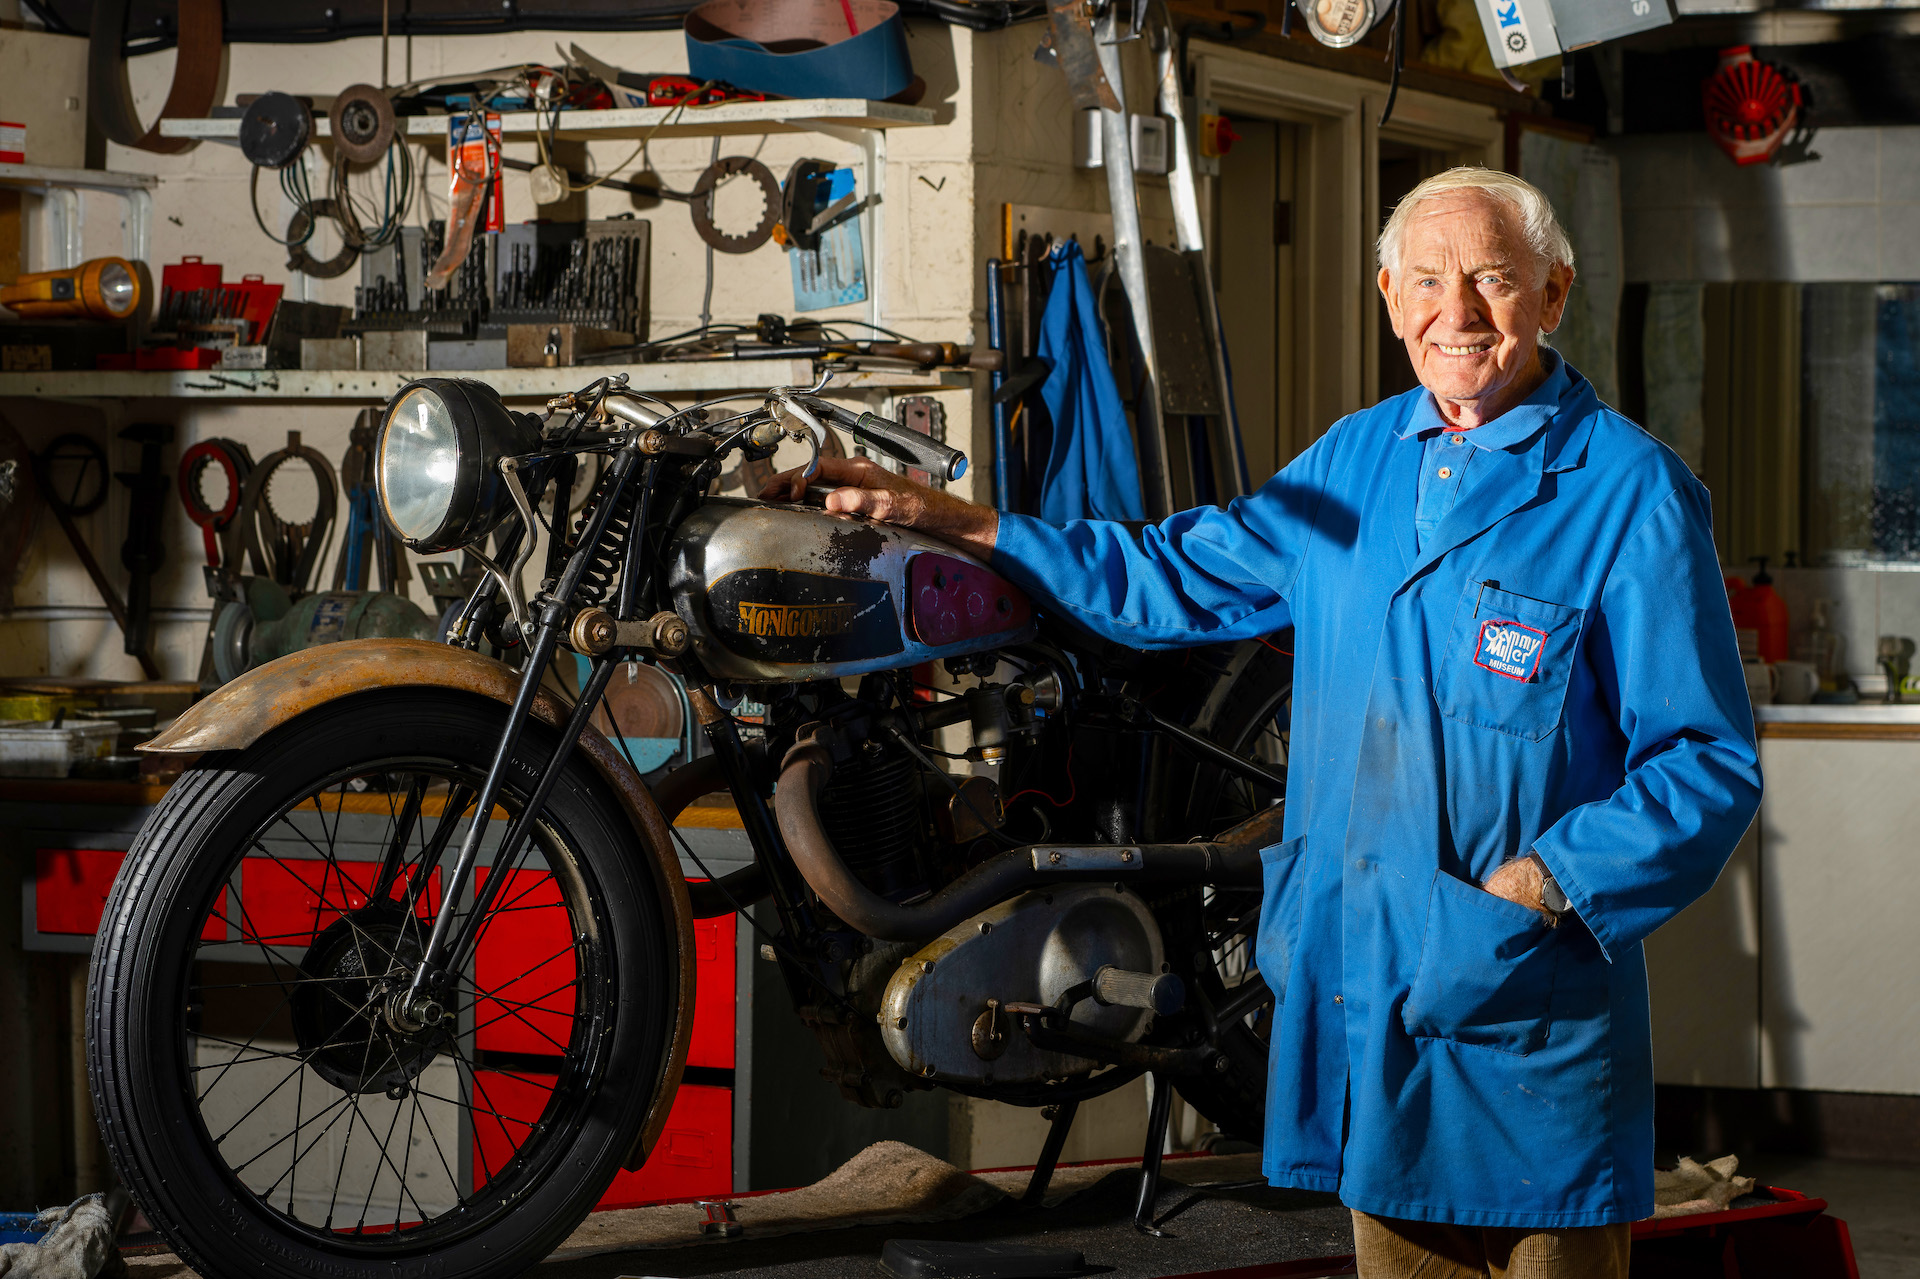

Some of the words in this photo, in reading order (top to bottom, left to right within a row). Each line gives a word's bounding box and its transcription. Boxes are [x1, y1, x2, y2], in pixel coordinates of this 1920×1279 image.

[1485, 625, 1540, 657] Sammy
[1485, 638, 1529, 664] Miller
[1488, 658, 1525, 676] MUSEUM
